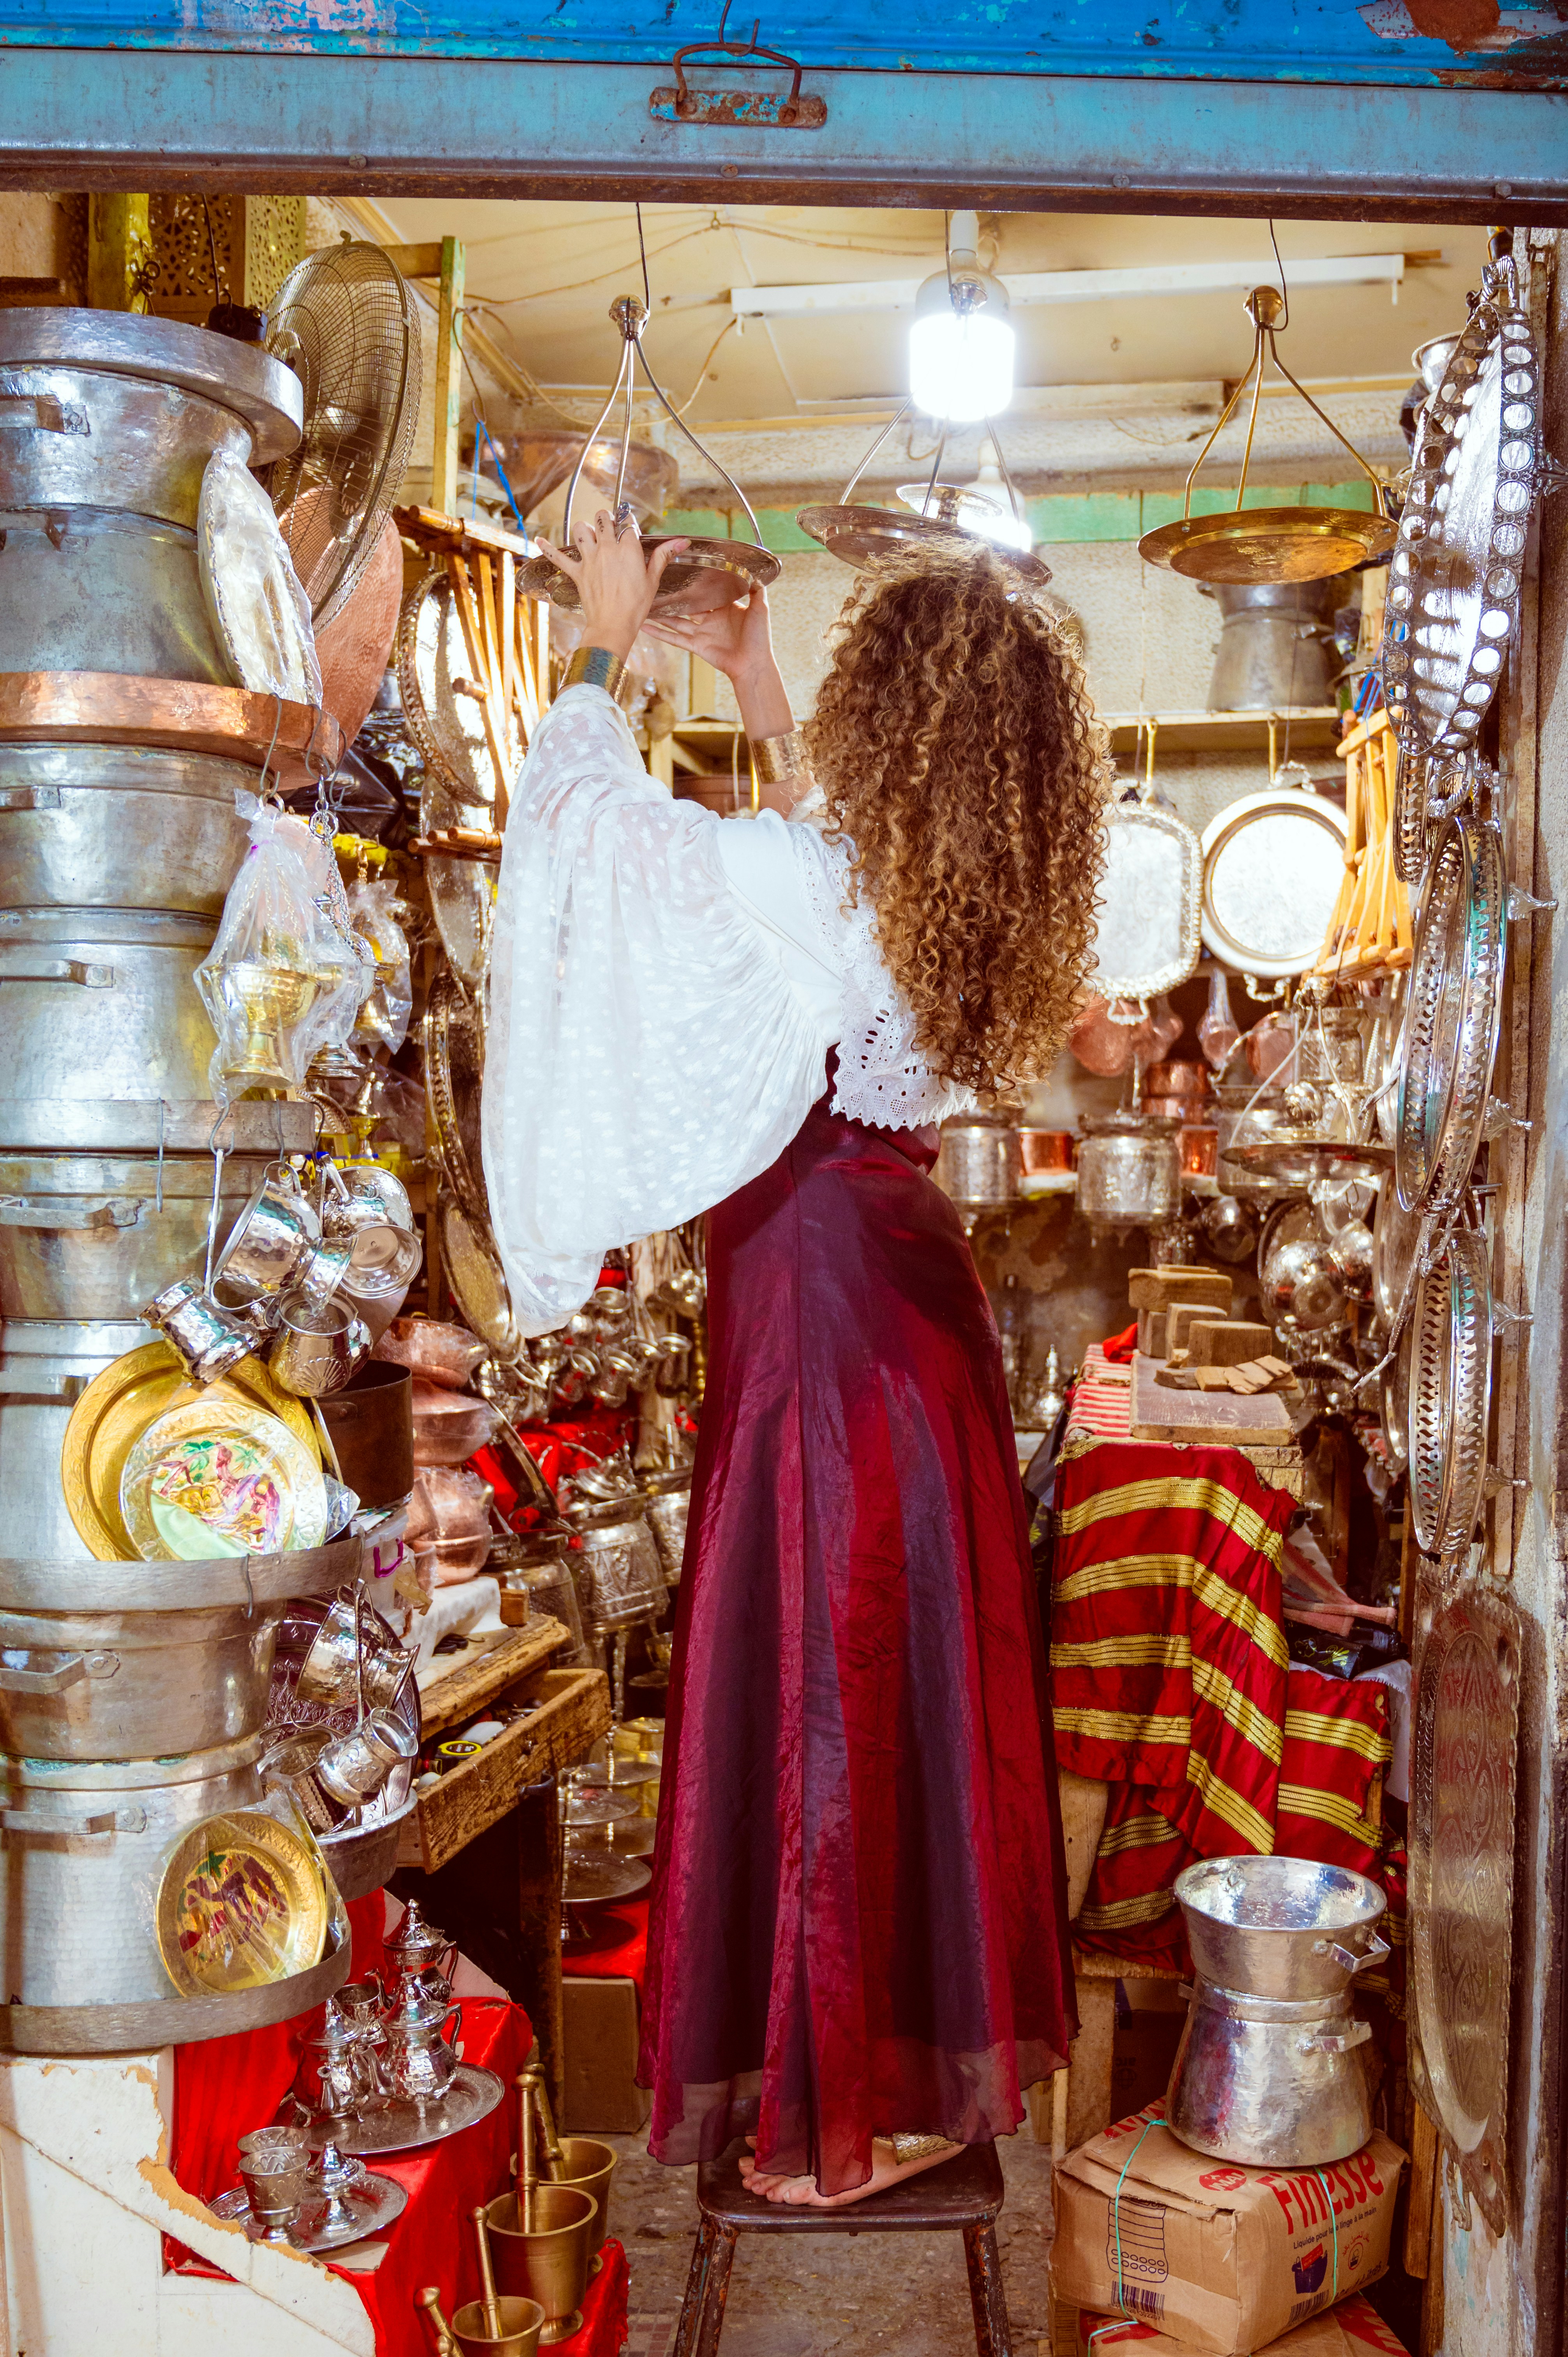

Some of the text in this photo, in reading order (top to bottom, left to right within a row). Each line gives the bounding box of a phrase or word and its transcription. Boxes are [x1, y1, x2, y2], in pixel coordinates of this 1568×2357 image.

[1255, 2150, 1384, 2235] Finesse
[1294, 2237, 1314, 2249] Liquide
[1316, 2230, 1328, 2242] pour
[1340, 2220, 1353, 2228] linge
[1364, 2207, 1377, 2217] main
